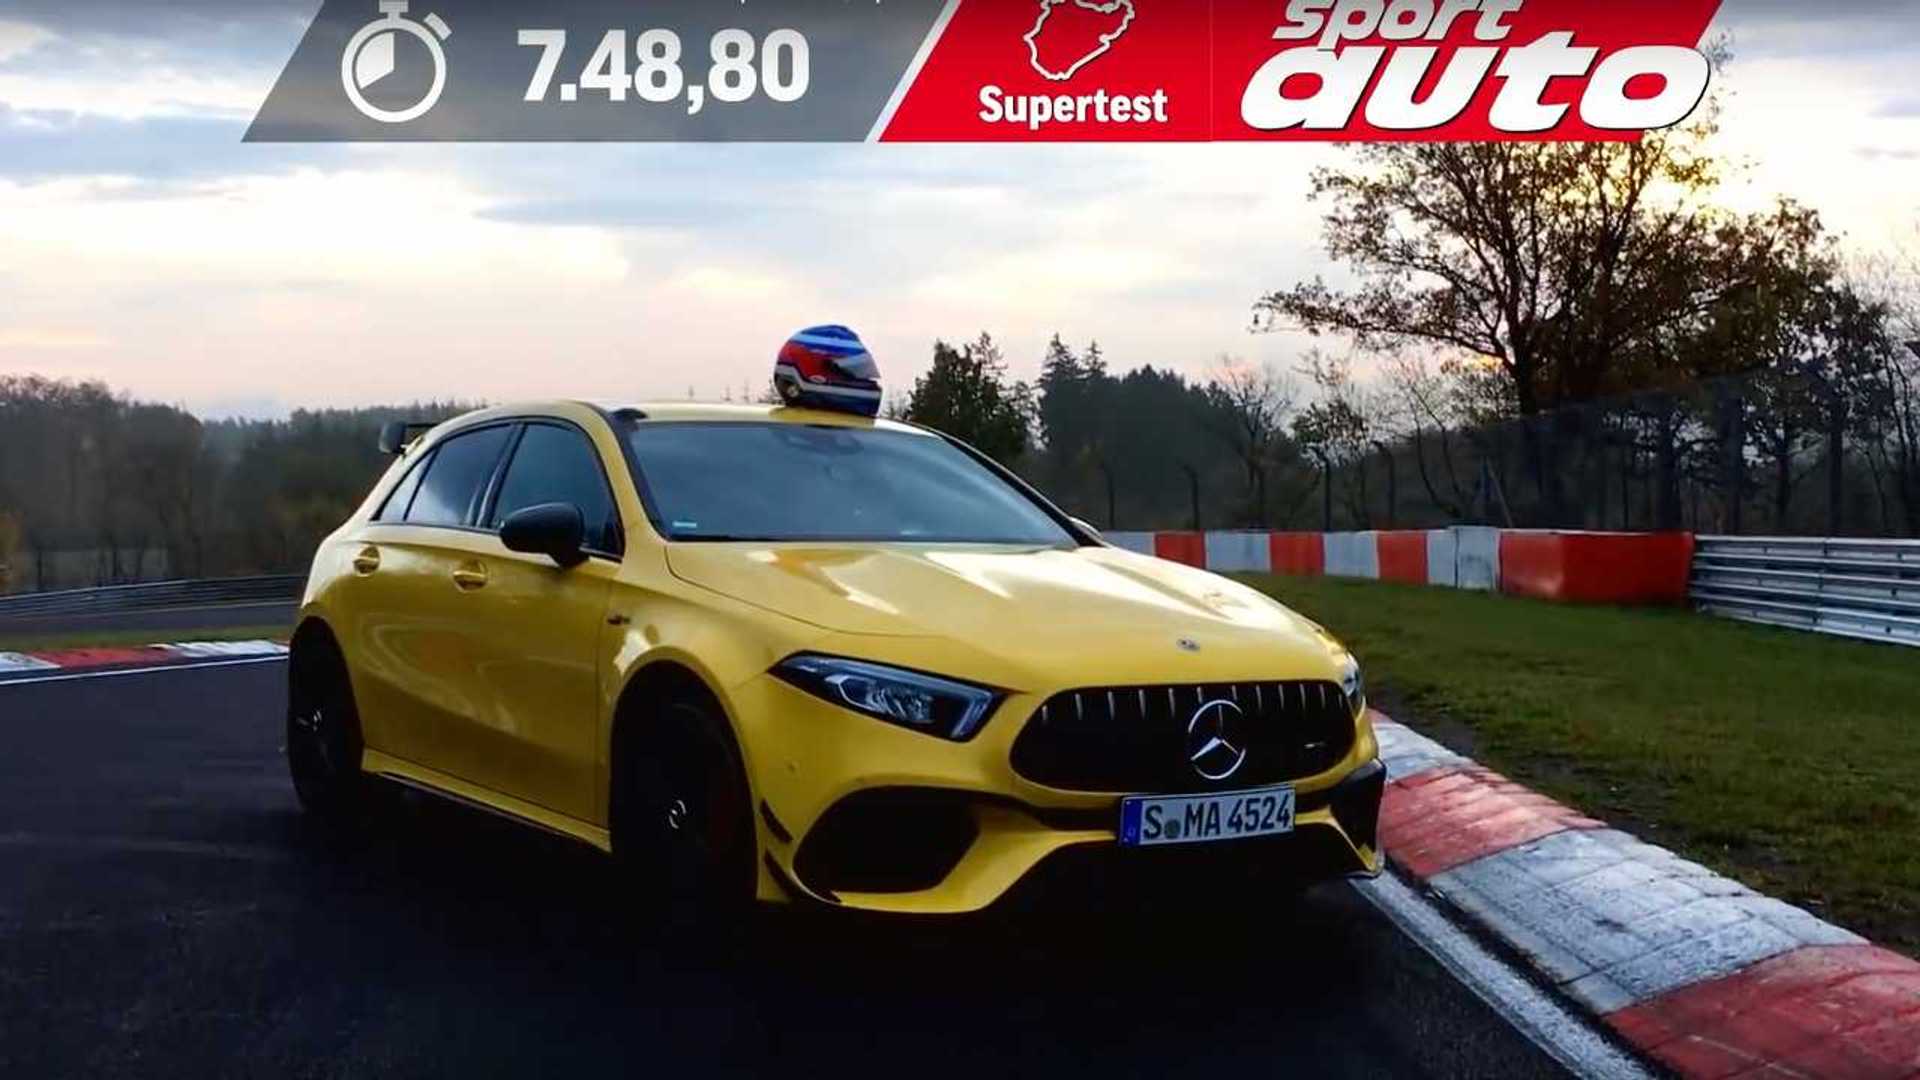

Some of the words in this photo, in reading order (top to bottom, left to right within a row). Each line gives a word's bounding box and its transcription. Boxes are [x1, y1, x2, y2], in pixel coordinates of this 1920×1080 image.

[1142, 804, 1163, 840] S
[1185, 800, 1221, 837] MA
[1228, 794, 1290, 832] 4524
